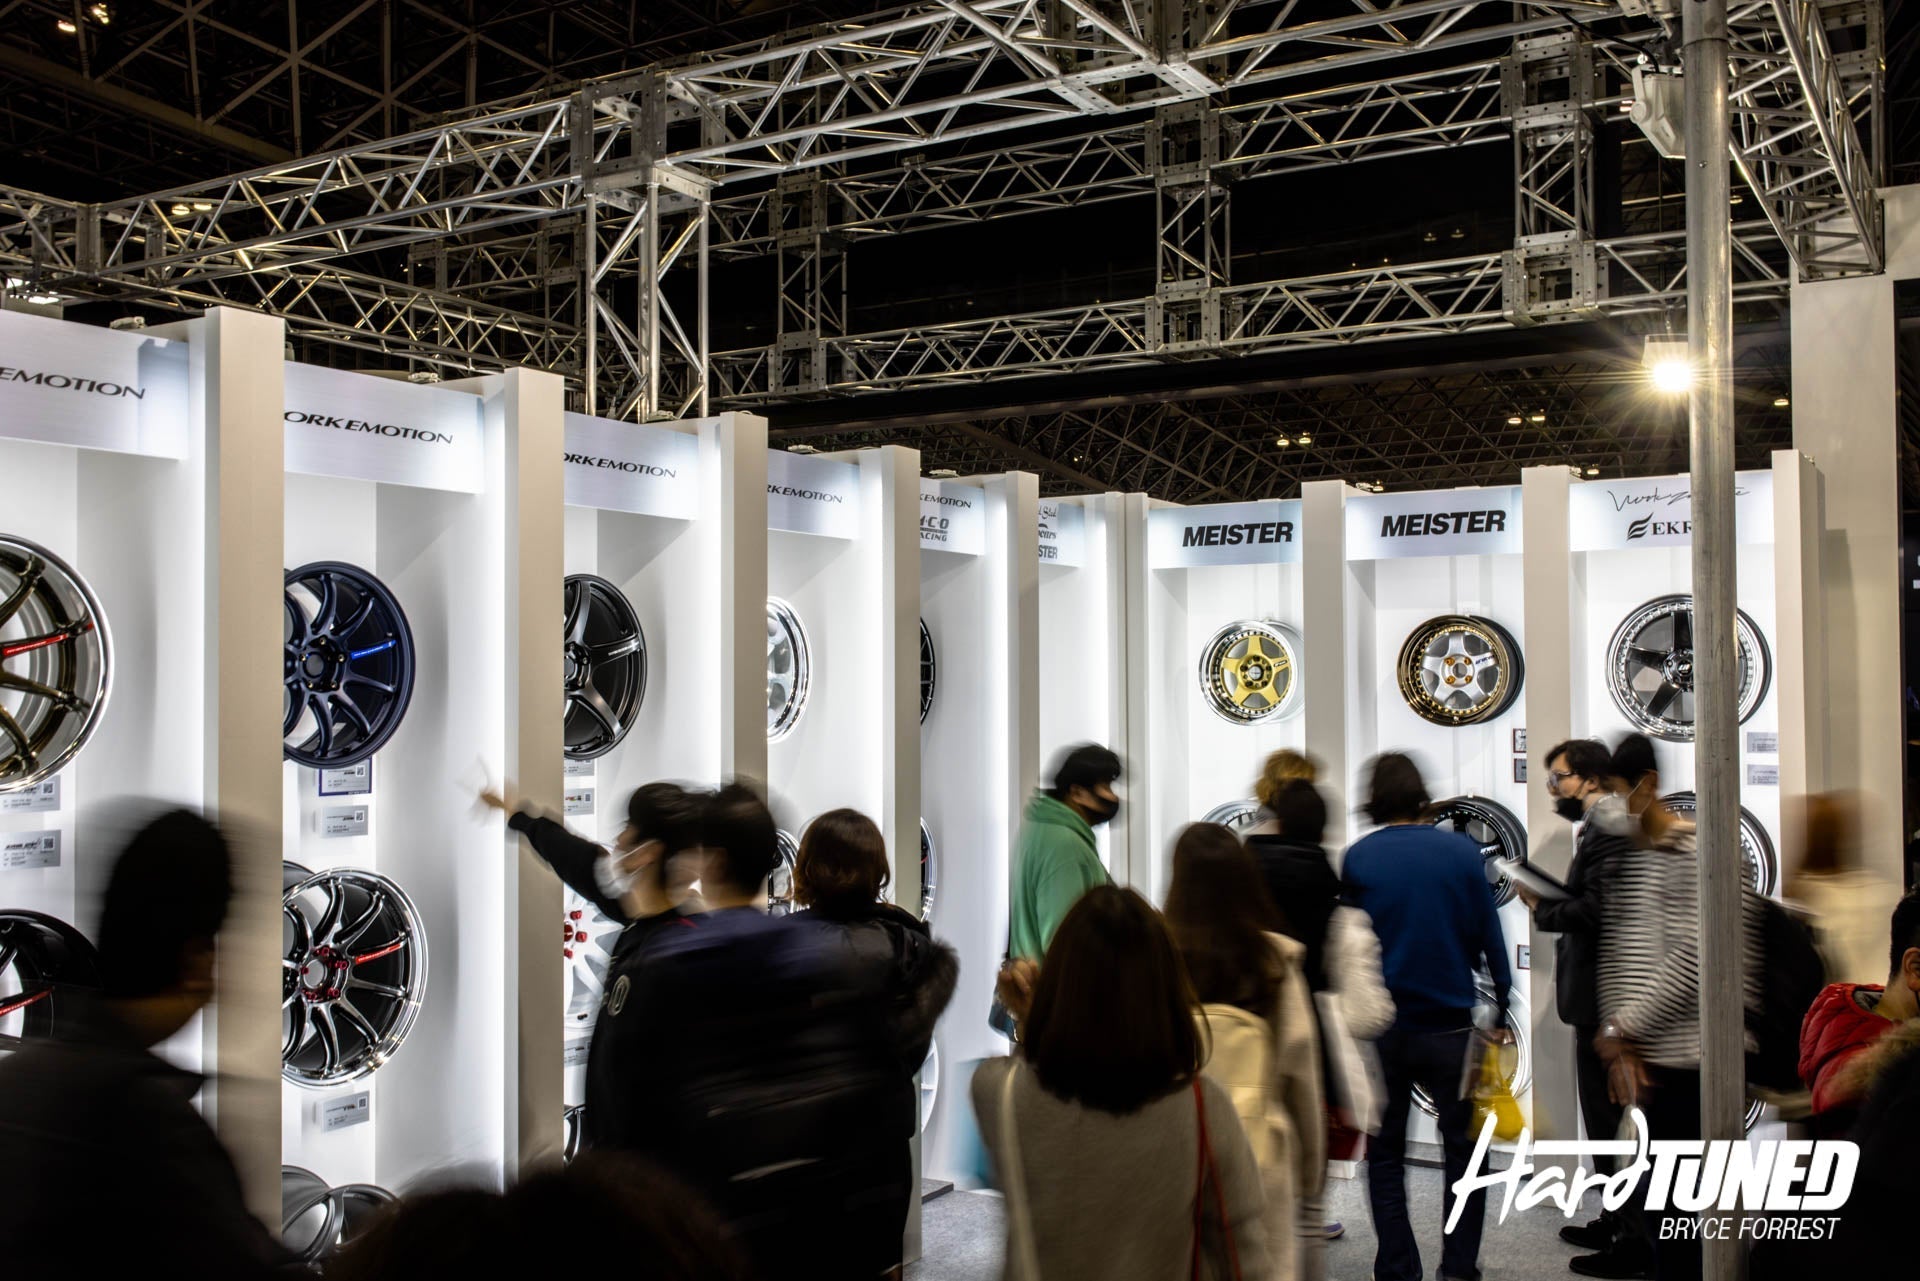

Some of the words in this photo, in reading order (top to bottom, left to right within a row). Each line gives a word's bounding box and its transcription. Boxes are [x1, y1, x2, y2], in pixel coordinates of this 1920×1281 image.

[0, 366, 145, 400] EMOTION
[284, 411, 344, 429] ORK
[1182, 522, 1294, 547] MEISTER
[1381, 510, 1506, 537] MEISTER
[1039, 545, 1058, 559] STER
